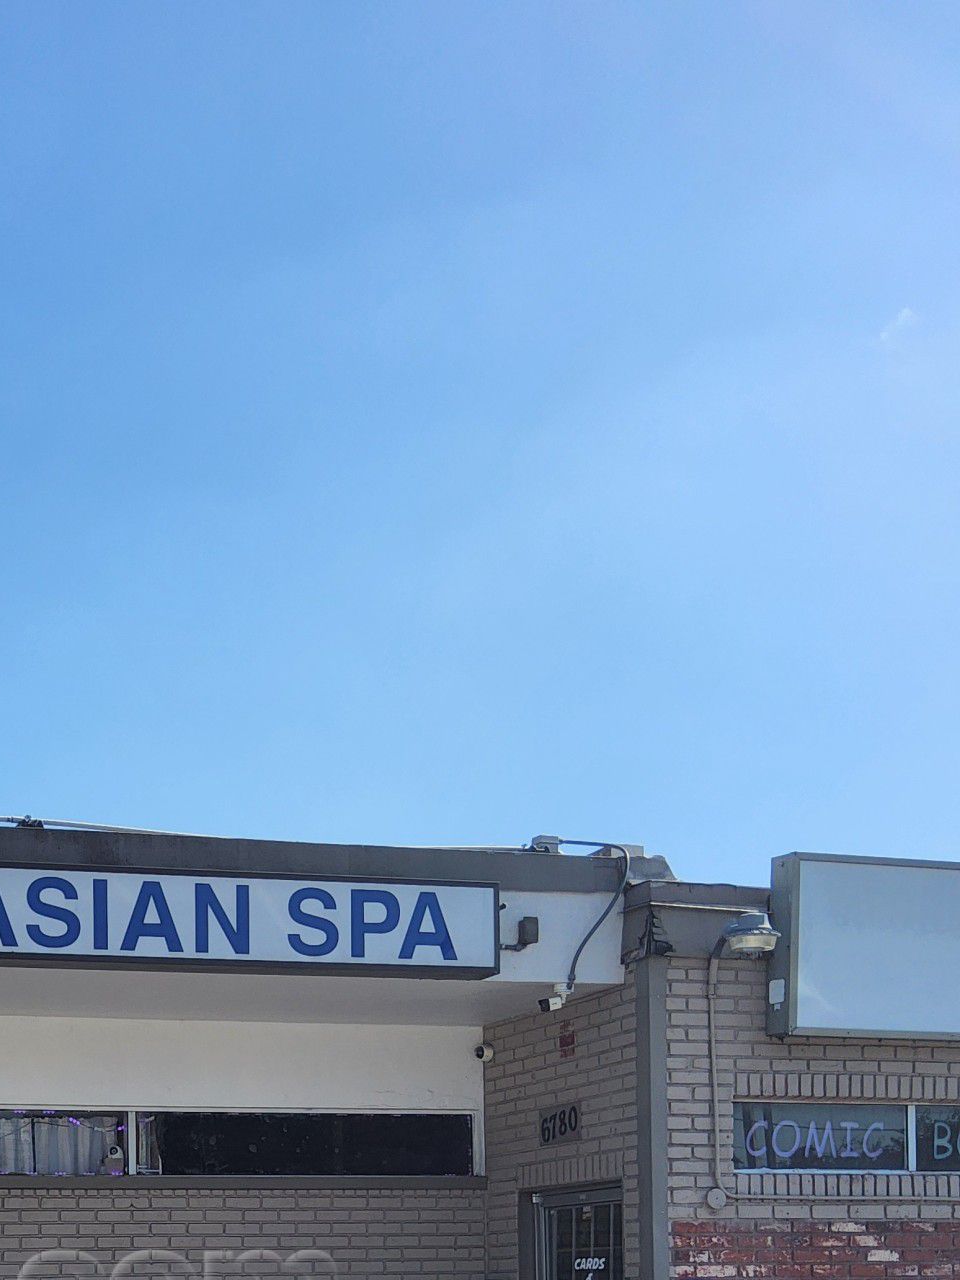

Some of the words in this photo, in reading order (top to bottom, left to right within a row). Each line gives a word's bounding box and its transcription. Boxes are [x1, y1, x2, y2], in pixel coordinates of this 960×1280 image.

[286, 887, 459, 961] SPA
[541, 1106, 579, 1143] 6780
[745, 1119, 885, 1160] COMIC
[933, 1119, 960, 1160] B
[574, 1257, 606, 1270] CARDS
